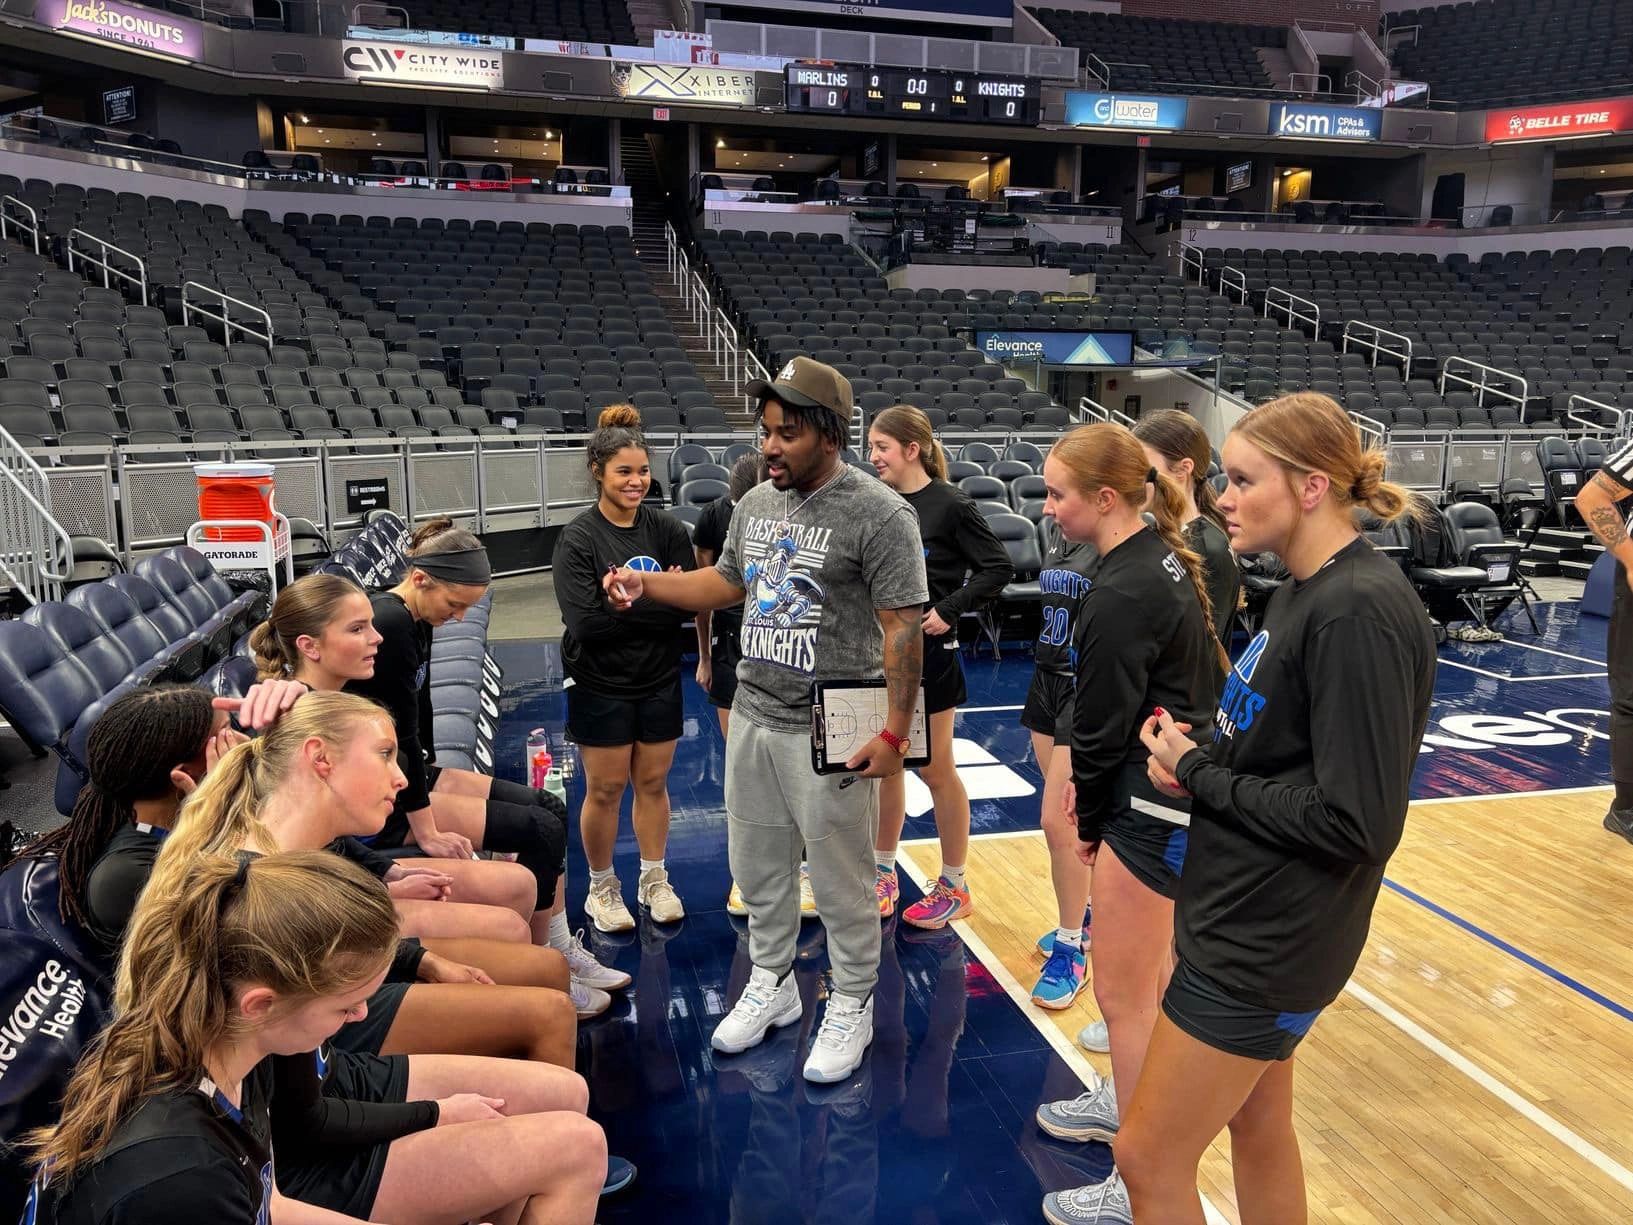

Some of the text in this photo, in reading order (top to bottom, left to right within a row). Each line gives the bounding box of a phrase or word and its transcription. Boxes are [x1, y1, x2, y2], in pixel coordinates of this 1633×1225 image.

[840, 6, 864, 14] DECK
[109, 11, 184, 44] DONUTS
[97, 28, 126, 43] SINCE
[409, 54, 500, 70] CITY WIDE
[690, 75, 754, 87] XIBER
[798, 71, 848, 86] MARLINS
[871, 75, 879, 87] 0
[955, 80, 963, 92] 0
[978, 82, 1026, 97] KNIGHTS
[828, 91, 837, 106] 0
[1006, 102, 1016, 116] 0
[1116, 103, 1156, 118] water
[1280, 105, 1329, 134] ksm
[1338, 117, 1357, 126] CPAs
[1525, 111, 1610, 129] BELLE TIRE
[1337, 127, 1370, 137] Advisors
[1189, 229, 1197, 241] 12
[745, 516, 832, 553] BASKTBALL
[204, 551, 258, 559] GATORADE
[755, 618, 774, 626] LOUIS
[1040, 605, 1069, 646] 20
[750, 627, 818, 673] KNIGHTS
